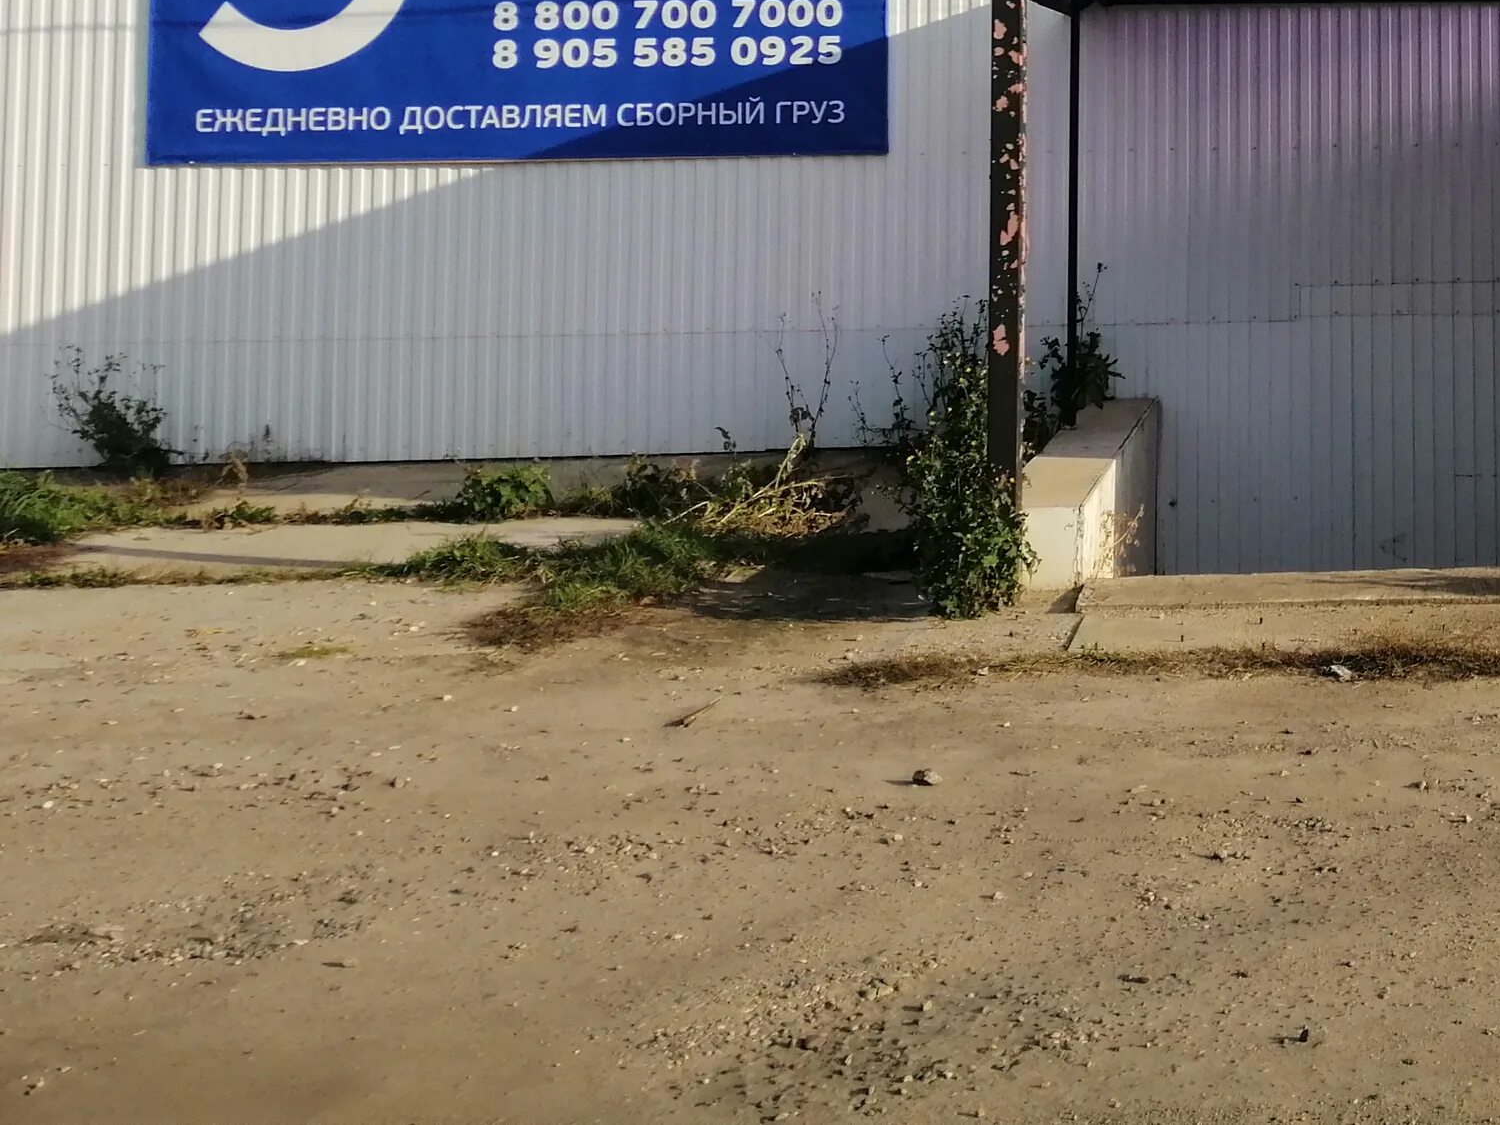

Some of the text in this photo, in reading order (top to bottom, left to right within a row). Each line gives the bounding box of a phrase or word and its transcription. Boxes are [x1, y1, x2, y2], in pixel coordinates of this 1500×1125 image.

[493, 1, 518, 31] 8
[534, 0, 618, 31] 800
[492, 35, 842, 69] 8 905 585 0925
[195, 96, 845, 137] ЕЖЕДНЕВНО ДОСТАВЛЯЕМ СБОРНЫЙ ГРУЗ
